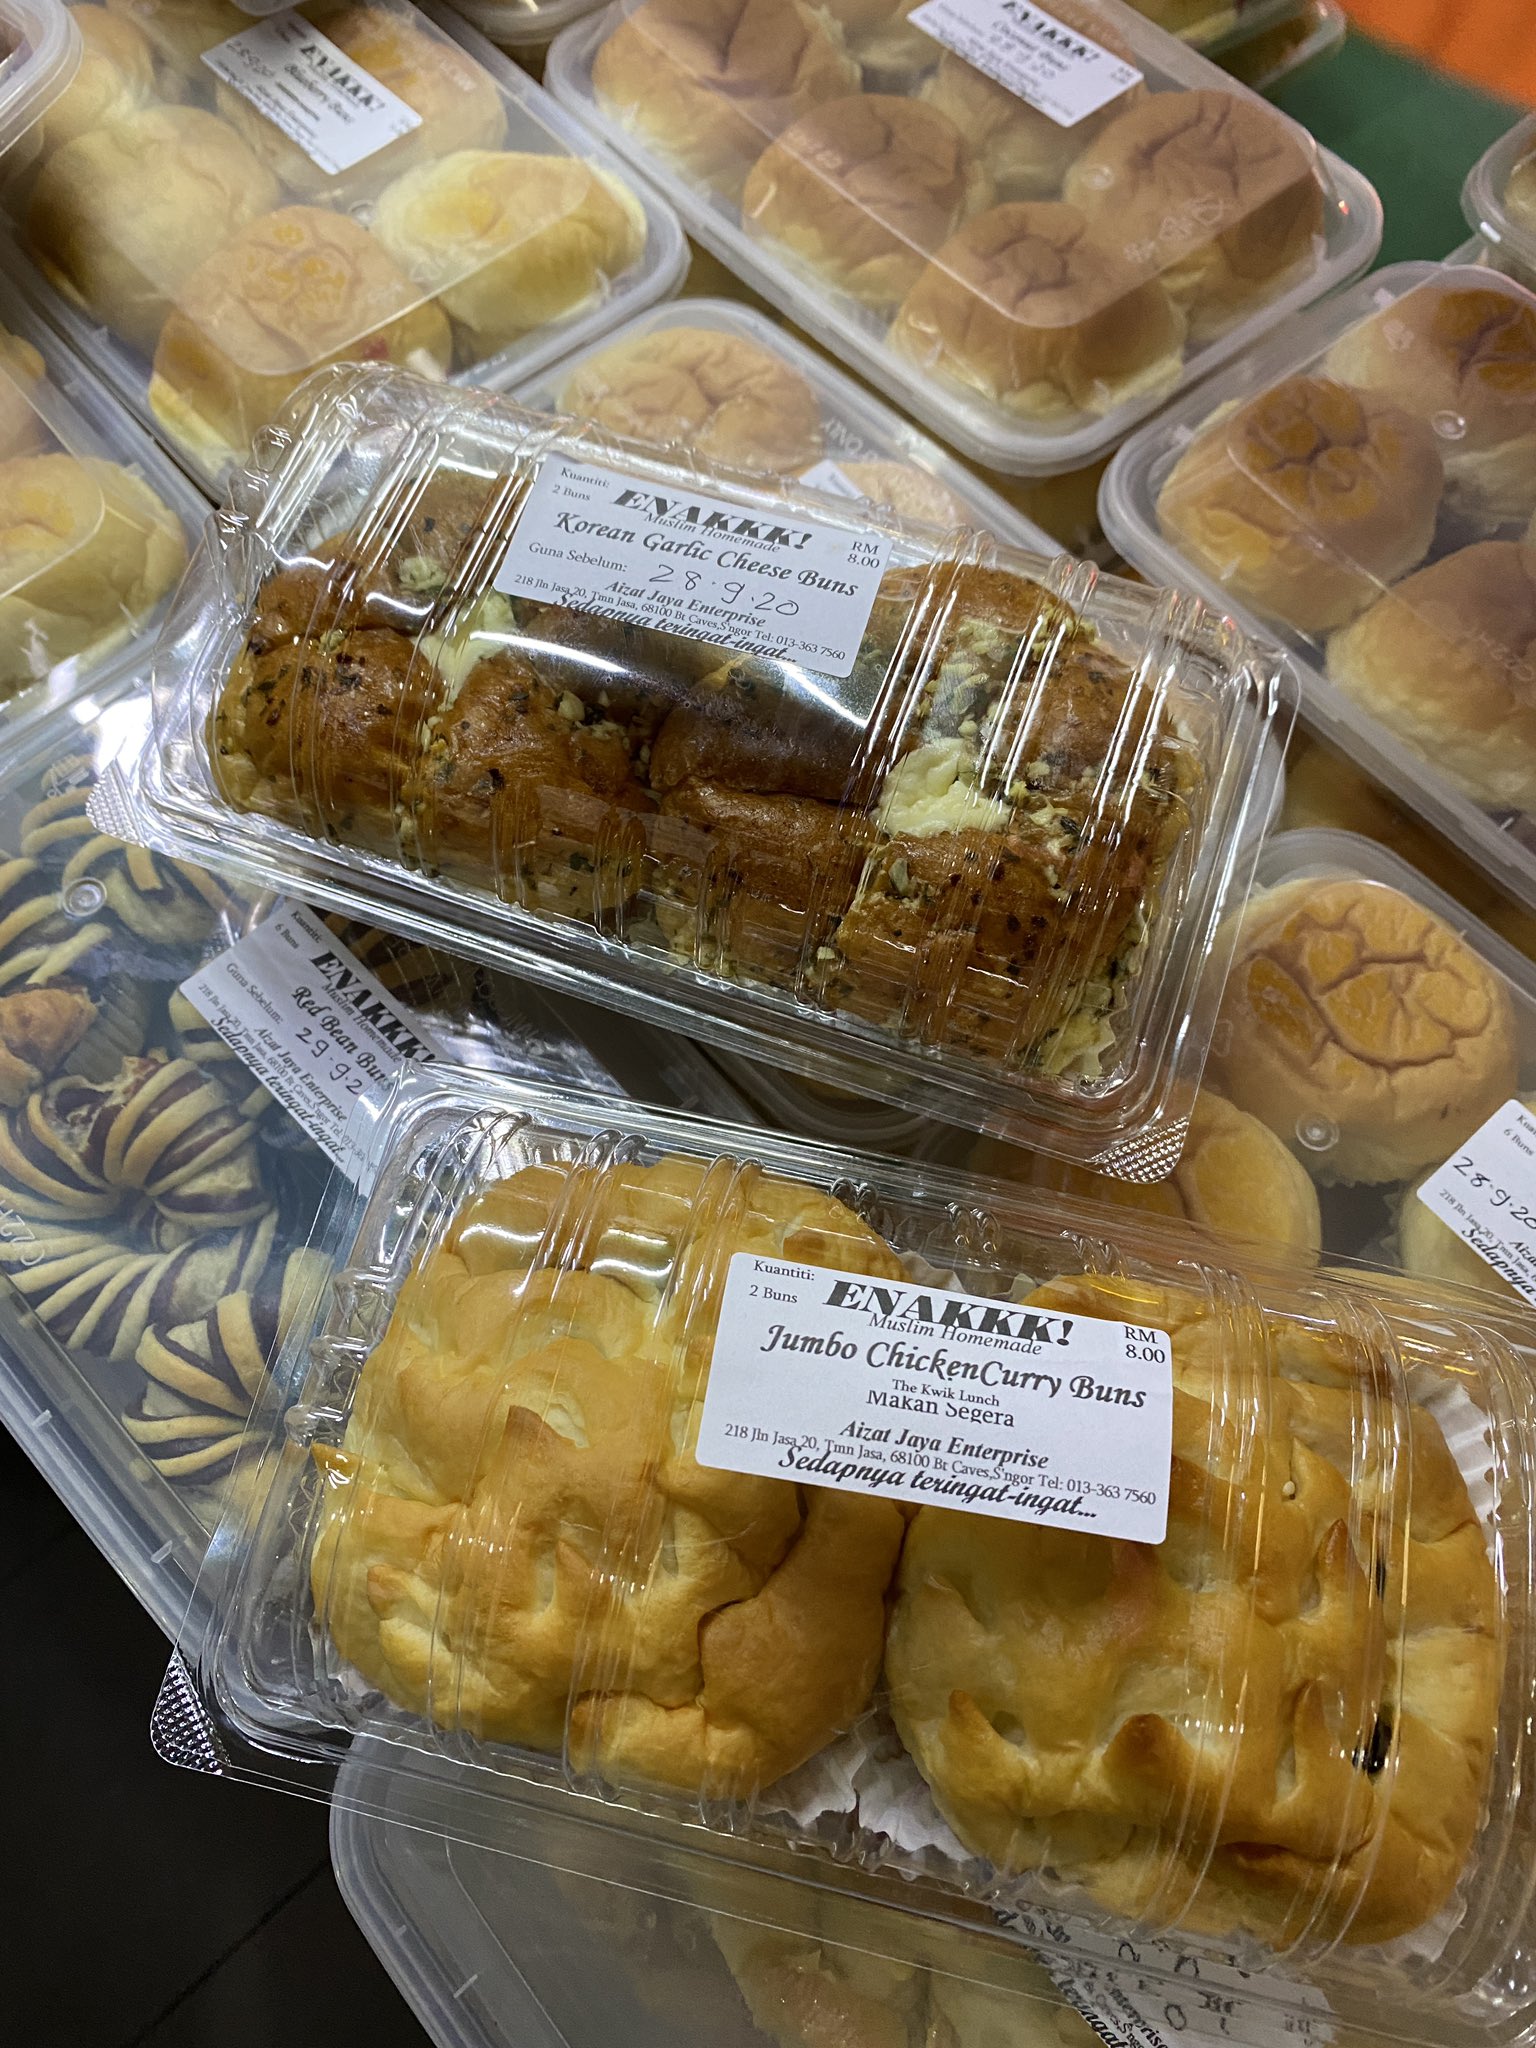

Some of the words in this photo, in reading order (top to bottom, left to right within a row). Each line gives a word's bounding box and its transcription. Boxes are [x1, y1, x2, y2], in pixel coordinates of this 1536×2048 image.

[552, 484, 561, 495] 2
[563, 486, 591, 501] Buns
[560, 466, 610, 489] Kuantiti:
[611, 489, 813, 550] ENAKKK!
[644, 512, 697, 533] Muslim
[700, 525, 781, 553] Homemade
[528, 541, 564, 558] Guna
[566, 549, 628, 573] Sebelum:
[554, 511, 636, 543] Korean
[643, 532, 714, 561] Garlic
[717, 550, 793, 580] Cheese
[797, 569, 859, 597] Buns
[847, 554, 880, 569] 8.00
[851, 541, 880, 556] RM
[514, 574, 534, 586] 218
[534, 578, 549, 589] Jln
[591, 590, 615, 604] Tmn
[615, 596, 638, 611] Jasa,
[641, 602, 673, 618] 68100
[674, 611, 685, 621] Bt
[754, 629, 774, 643] Tel:
[776, 635, 818, 654] 013-363
[820, 646, 846, 661] 7560
[604, 580, 646, 598] Aizat
[647, 590, 685, 608] Jaya
[687, 599, 767, 628] Enterprise
[274, 923, 285, 932] 6
[226, 962, 249, 988] Guna
[246, 984, 284, 1025] Sebelum:
[321, 982, 355, 1016] Muslim
[291, 986, 332, 1017] Red
[320, 1015, 358, 1055] Bean
[211, 1016, 269, 1076] Sedapnya
[254, 1028, 282, 1051] Aizat
[277, 1051, 302, 1075] Jaya
[299, 1073, 348, 1124] Enterprise
[1503, 1128, 1512, 1137] 6
[1511, 1134, 1535, 1156] Buns
[1439, 1188, 1457, 1206] 218
[753, 1259, 815, 1281] Kuantiti:
[1461, 1228, 1536, 1295] Sedapnya
[749, 1284, 759, 1297] 2
[762, 1286, 798, 1304] Buns
[821, 1279, 1074, 1346] ENAKKK!
[867, 1312, 935, 1338] Muslim
[941, 1324, 1042, 1355] Homemade
[1123, 1324, 1159, 1345] RM
[1125, 1343, 1166, 1364] 8.00
[760, 1324, 858, 1360] Jumbo
[1069, 1375, 1147, 1408] Buns
[865, 1390, 940, 1415] Makan
[945, 1403, 1015, 1427] Segera
[892, 1378, 918, 1394] The
[920, 1383, 955, 1400] Kwik
[958, 1389, 1000, 1407] Lunch
[724, 1423, 749, 1439] 218
[750, 1427, 769, 1443] Jln
[801, 1435, 820, 1451] 20,
[824, 1438, 855, 1456] Tmn
[857, 1444, 887, 1463] Jasa,
[890, 1449, 931, 1468] 68100
[932, 1457, 948, 1471] Bt
[1038, 1474, 1064, 1491] Tel:
[1066, 1478, 1121, 1499] 013-363
[1123, 1487, 1157, 1506] 7560
[839, 1420, 892, 1443] Aizat
[895, 1428, 942, 1453] Jaya
[947, 1436, 1050, 1469] Enterprise
[777, 1444, 906, 1488] Sedapnya
